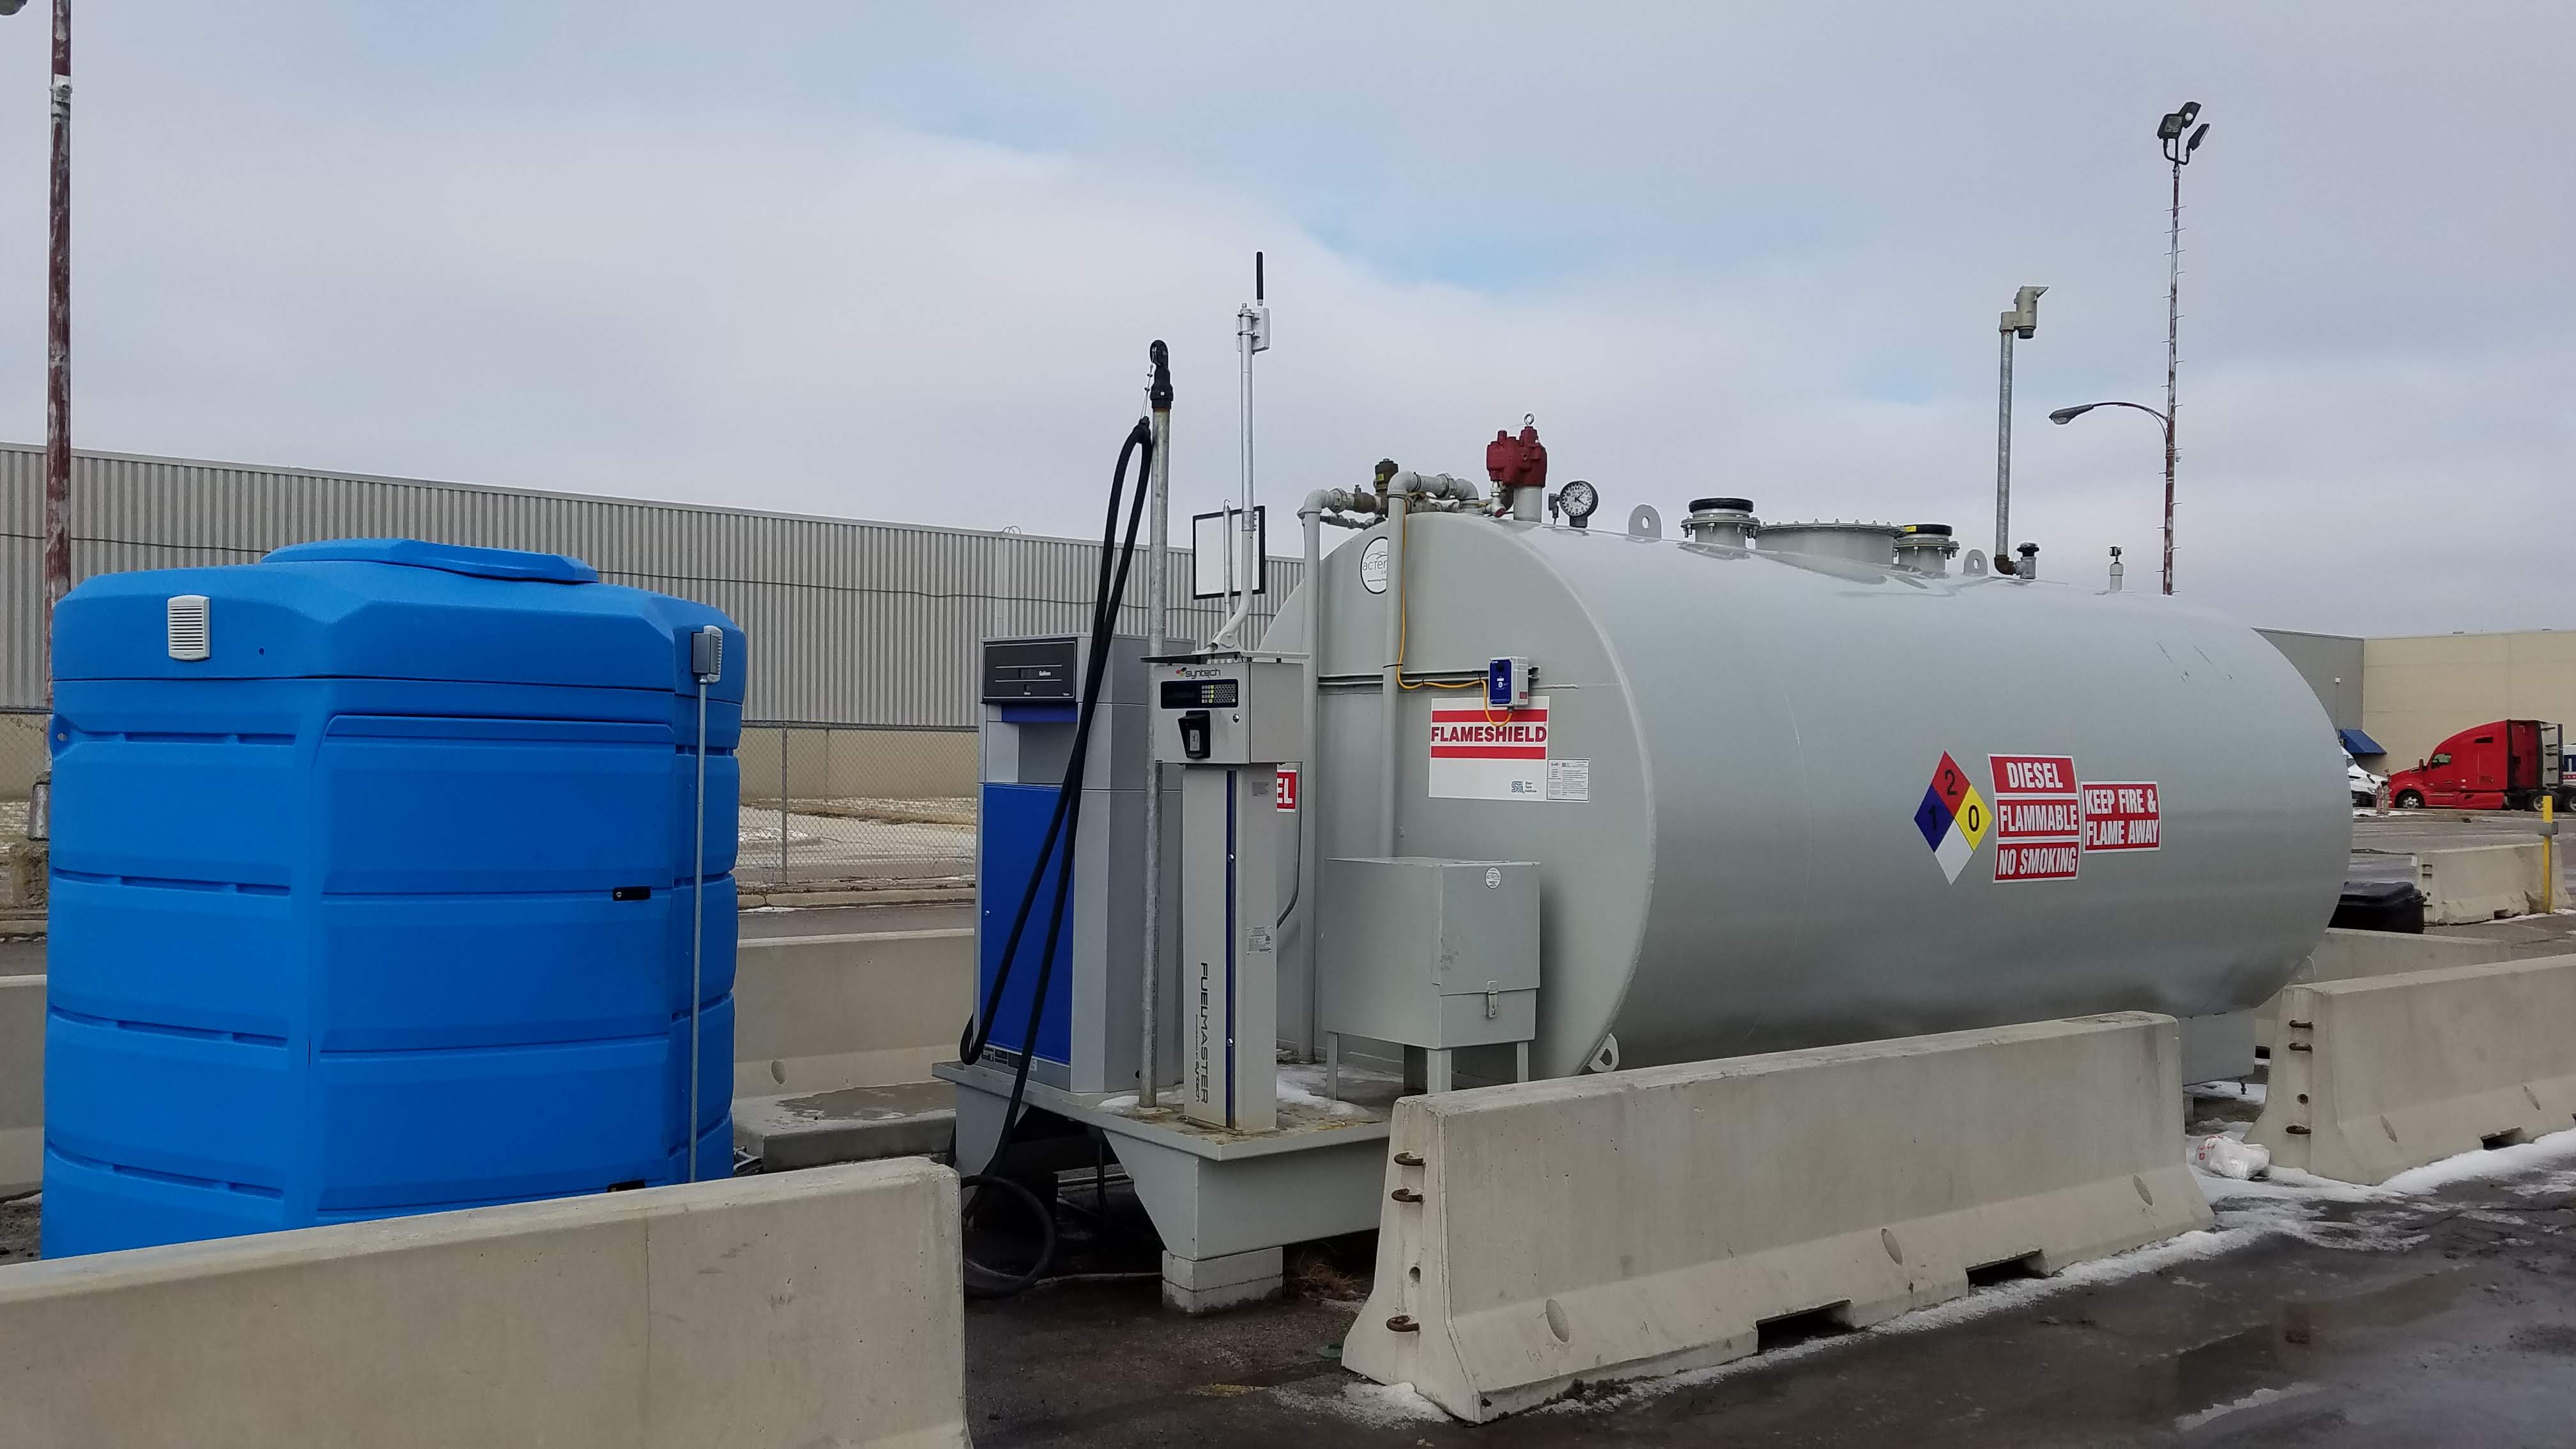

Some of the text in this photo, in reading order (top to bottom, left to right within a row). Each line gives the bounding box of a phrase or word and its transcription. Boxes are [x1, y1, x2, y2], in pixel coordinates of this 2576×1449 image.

[1185, 668, 1221, 679] syntech
[1431, 726, 1547, 742] FLAMESHIELD
[1944, 769, 1958, 795] 2
[2006, 762, 2064, 789] DIESEL
[2085, 788, 2158, 815] KEEP FIRE &
[1928, 804, 1980, 832] 1 0
[2000, 804, 2078, 832] FLAMMABLE
[2086, 819, 2159, 846] FLAME AWAY
[1998, 847, 2076, 876] NO SMOKING
